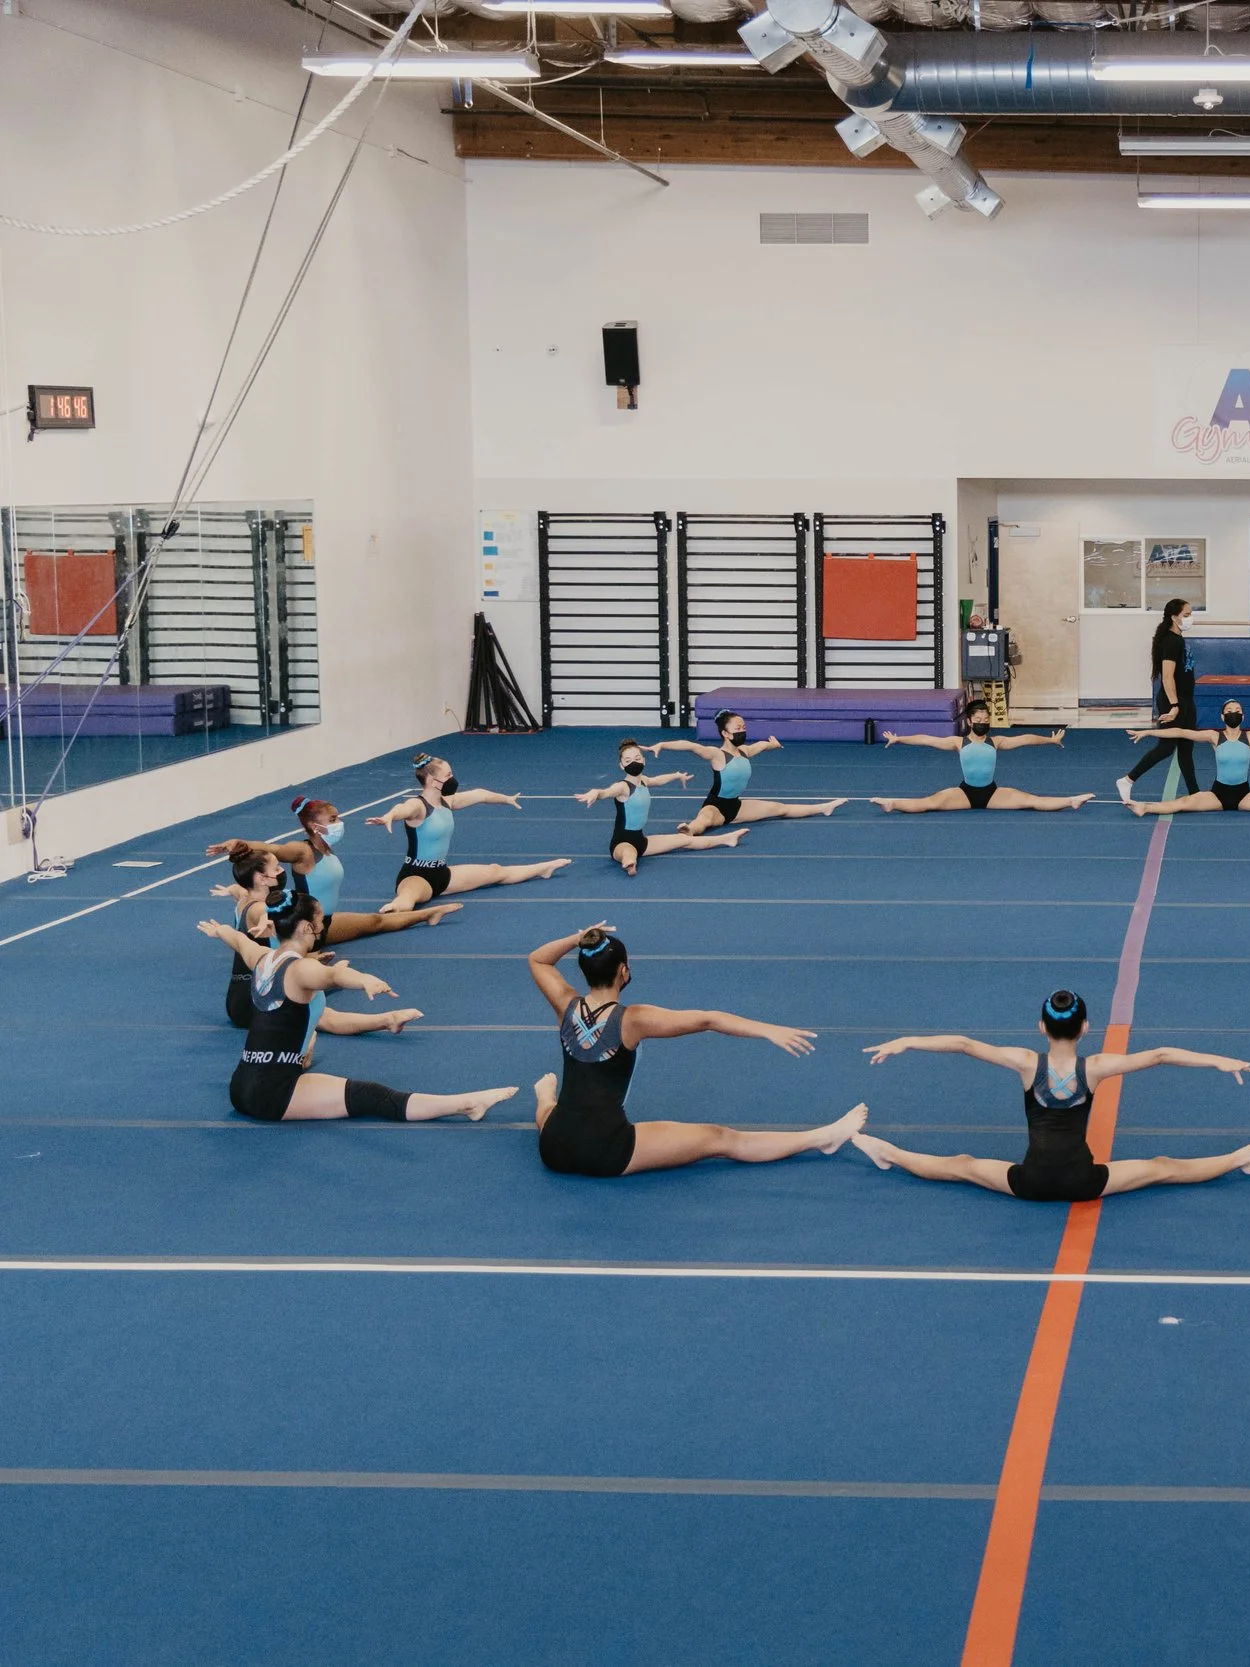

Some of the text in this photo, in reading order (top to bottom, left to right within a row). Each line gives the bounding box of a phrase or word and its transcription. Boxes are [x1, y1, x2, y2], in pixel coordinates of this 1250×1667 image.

[1225, 456, 1250, 464] AERIAL
[412, 859, 436, 868] NIKE
[250, 1051, 274, 1064] PRO
[277, 1051, 304, 1065] NIKE
